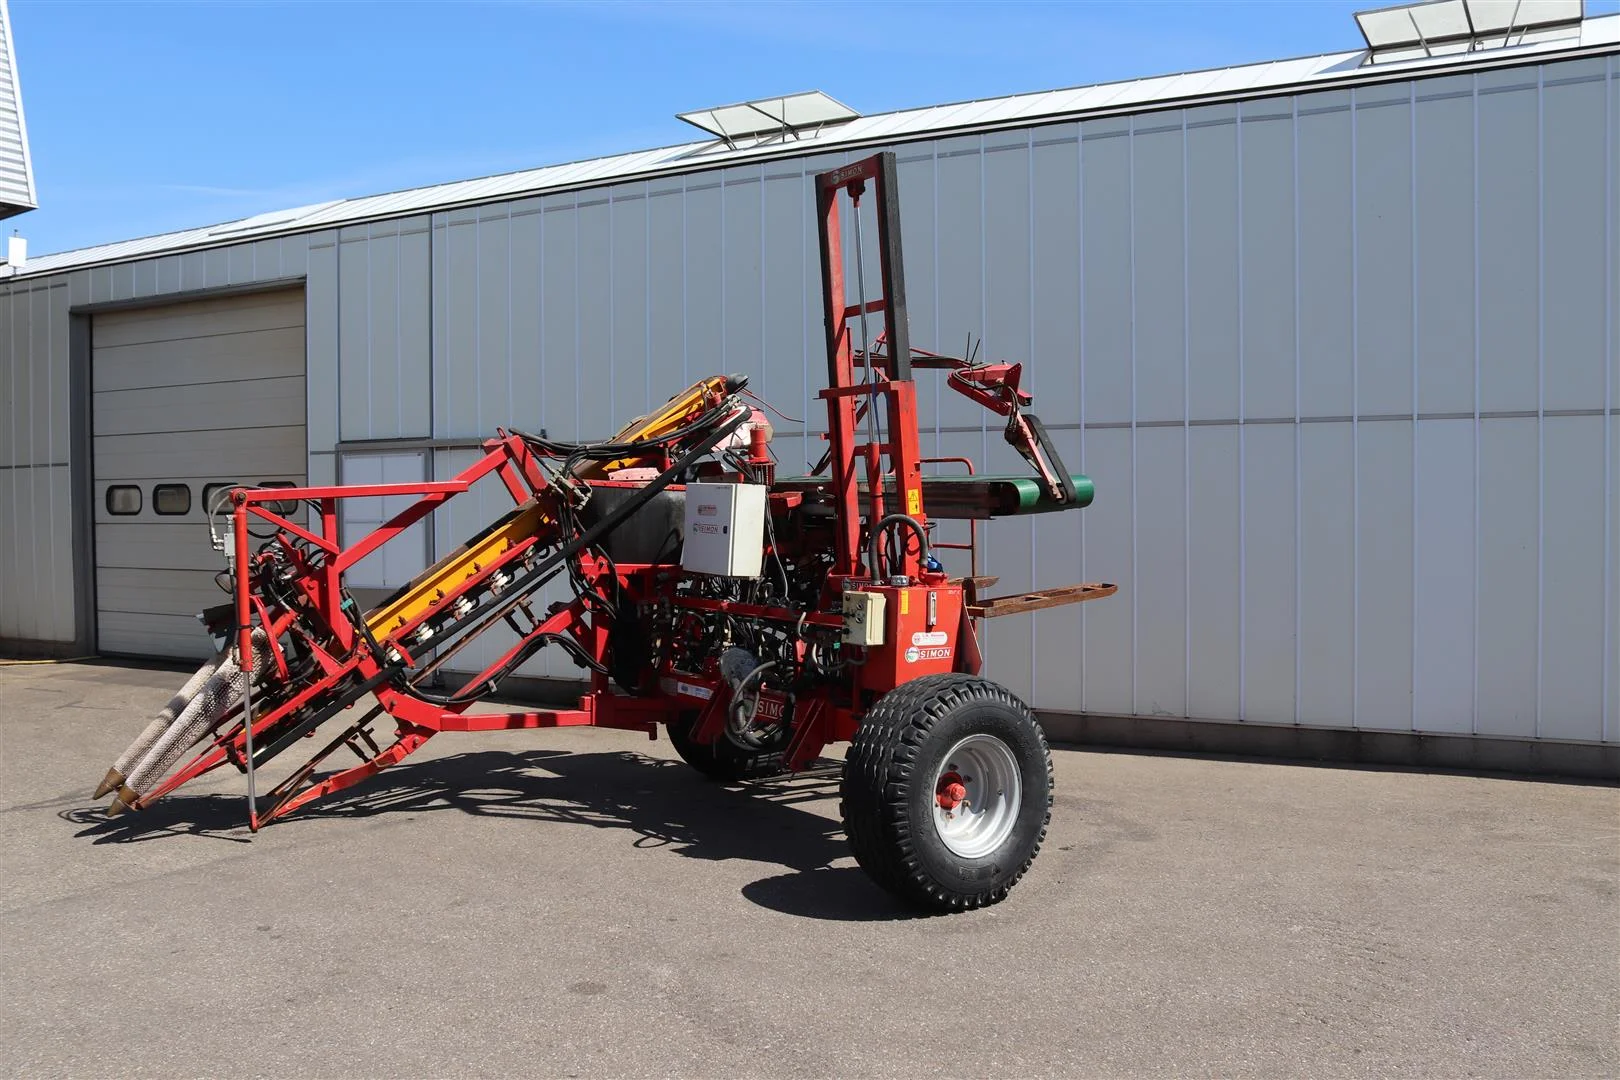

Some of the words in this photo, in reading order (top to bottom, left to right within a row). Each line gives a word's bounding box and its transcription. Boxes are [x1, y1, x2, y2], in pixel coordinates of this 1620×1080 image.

[841, 165, 863, 178] SIMON
[920, 649, 951, 658] SIMON
[758, 701, 796, 721] SIMO
